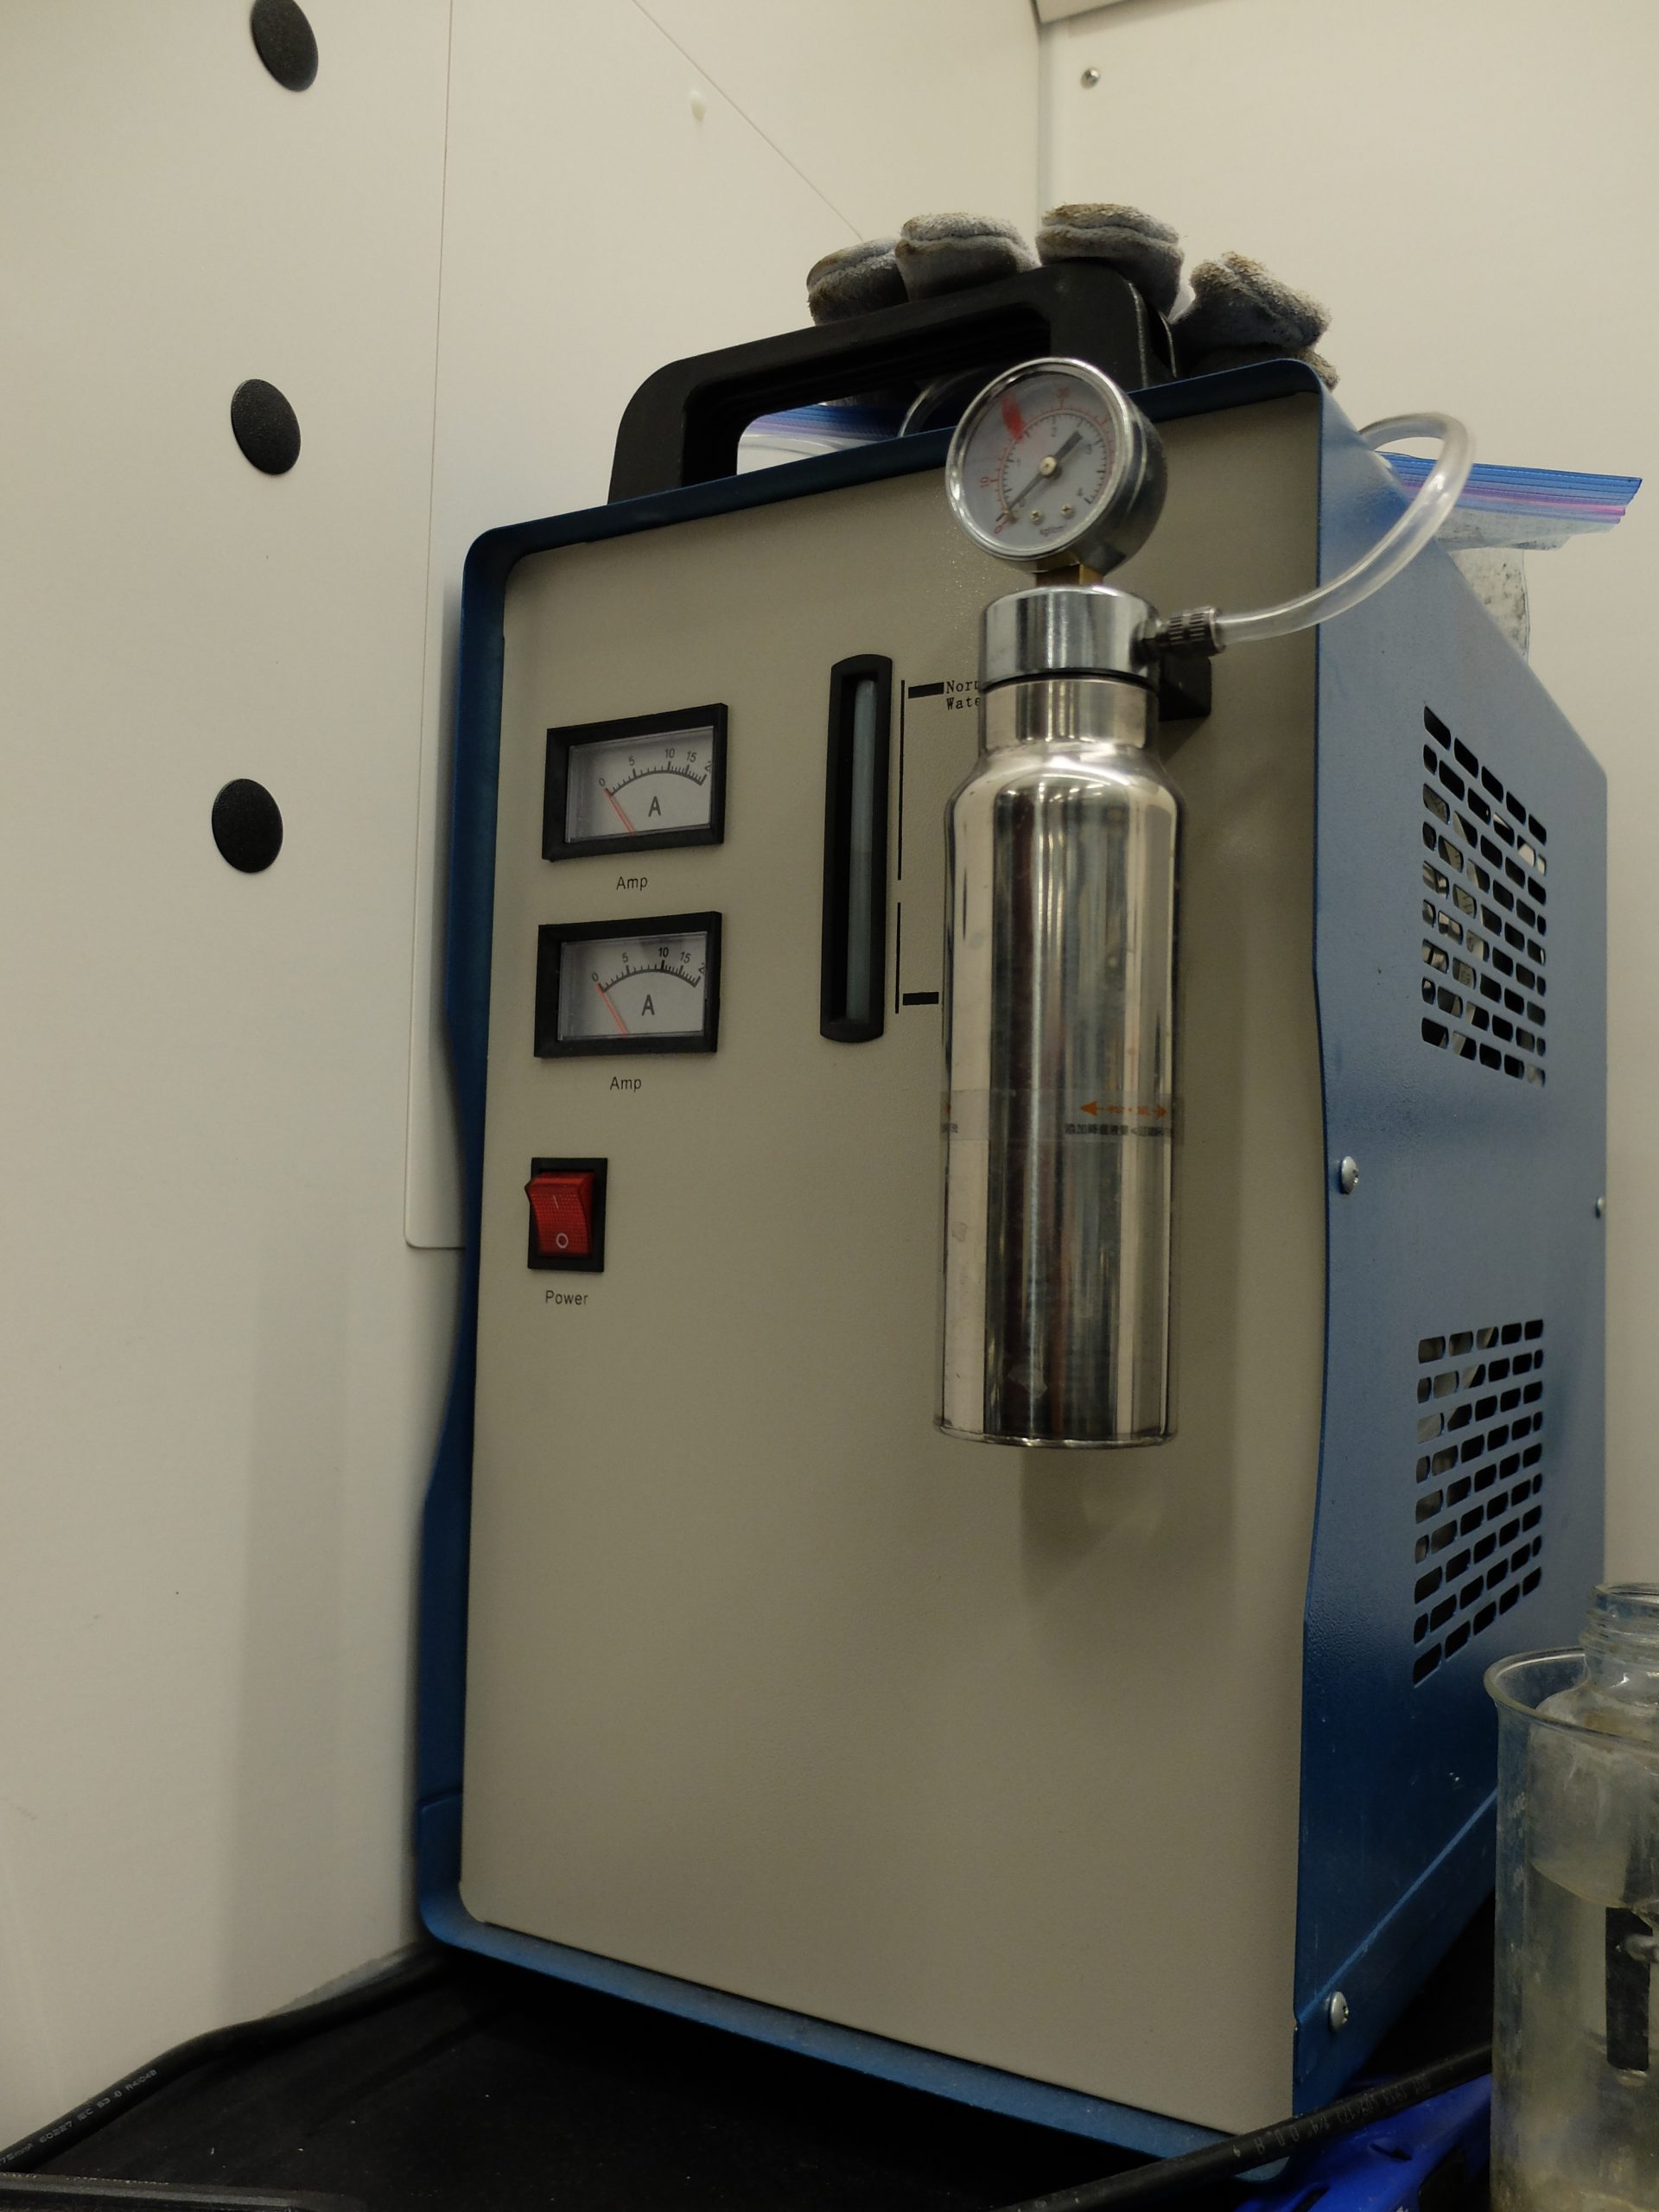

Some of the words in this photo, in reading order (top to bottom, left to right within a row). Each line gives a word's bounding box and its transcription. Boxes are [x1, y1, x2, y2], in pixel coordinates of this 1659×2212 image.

[628, 756, 636, 766] 5
[664, 748, 676, 759] 10
[686, 751, 697, 763] 15
[648, 796, 662, 817] A
[616, 876, 648, 892] Amp
[621, 952, 629, 963] 5
[658, 947, 670, 958] 10
[680, 951, 691, 963] 15
[641, 994, 655, 1016] A
[609, 1076, 642, 1092] Amp
[545, 1289, 588, 1306] Power
